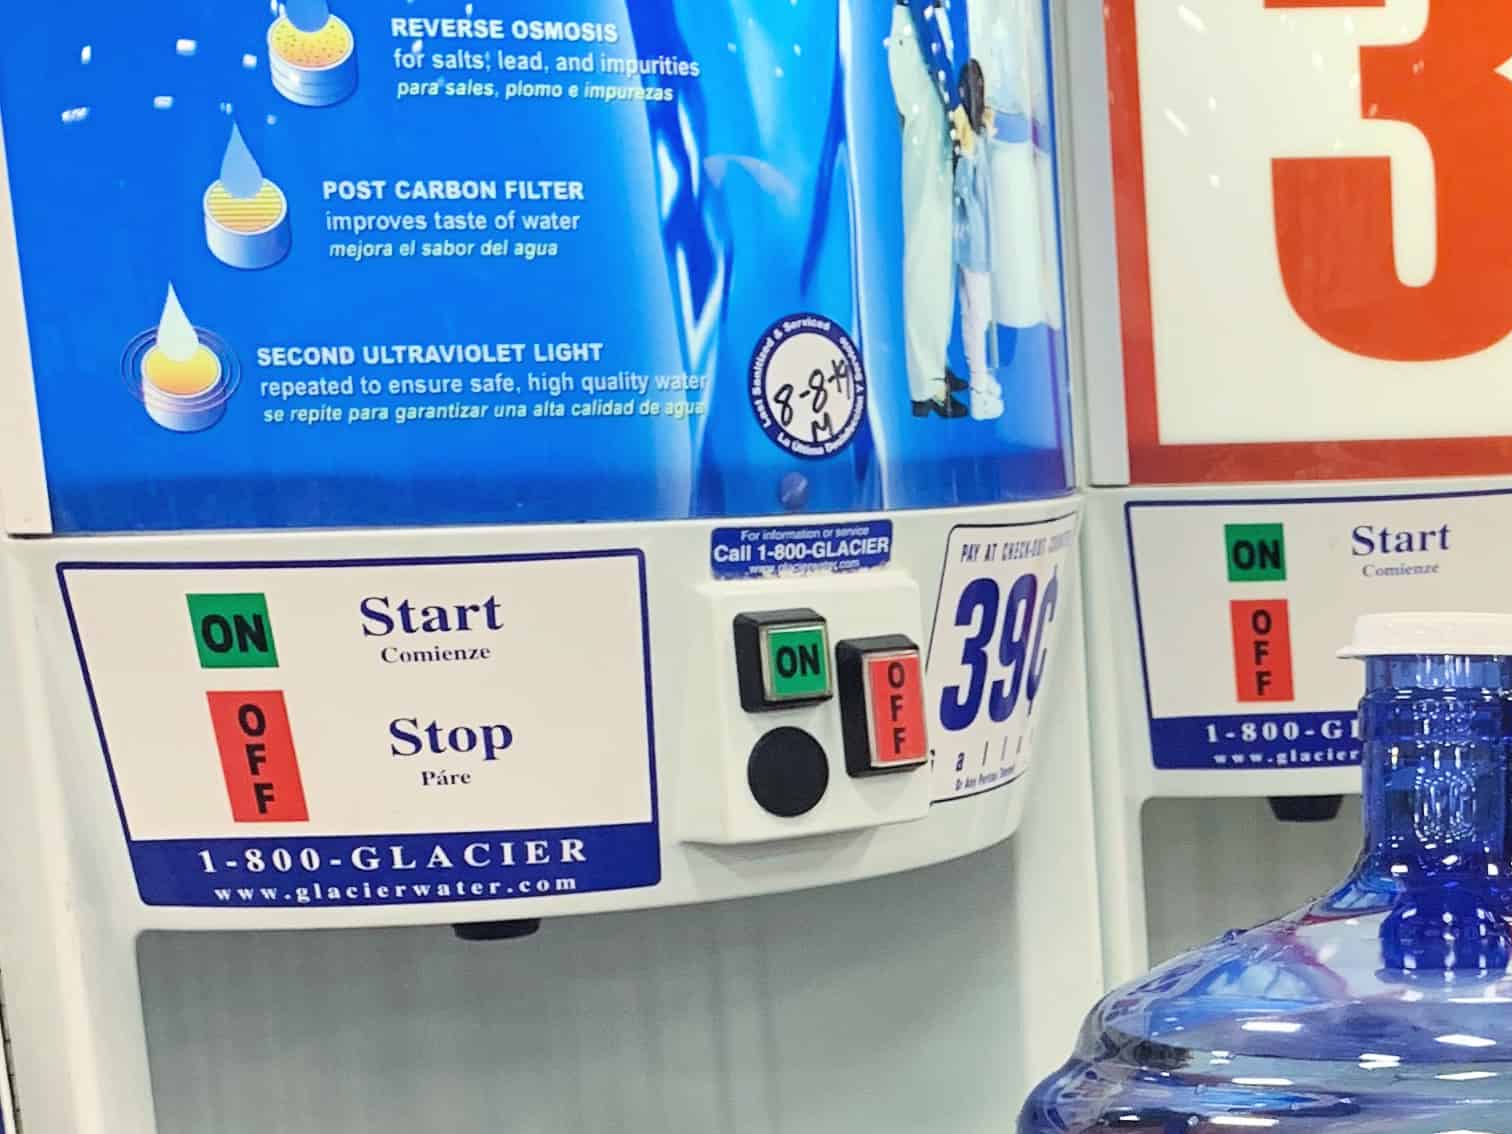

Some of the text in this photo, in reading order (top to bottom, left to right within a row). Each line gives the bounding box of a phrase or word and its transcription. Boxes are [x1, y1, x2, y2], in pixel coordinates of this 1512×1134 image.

[391, 18, 618, 42] REVERSE OSMOSIS
[393, 48, 424, 69] for
[497, 51, 549, 73] lead,
[556, 53, 594, 72] and
[600, 54, 700, 77] impurities
[397, 80, 438, 99] para
[505, 80, 562, 100] plomo
[568, 83, 579, 98] e
[584, 82, 673, 102] impurezas
[323, 180, 585, 200] POST CARBON FILTER
[326, 210, 581, 234] improves taste of water
[329, 240, 558, 261] mejora el sabor del agua
[256, 343, 603, 366] SECOND ULTRAVIOLET LIGHT
[260, 371, 708, 400] repeated to ensure safe, high quality water
[263, 400, 705, 424] se repite para garantizar una alta calidad de agua
[741, 530, 761, 542] For
[1352, 524, 1451, 557] Start
[714, 537, 890, 562] Call 1-800-GLACIER
[960, 543, 981, 562] PAY
[984, 543, 997, 562] AT
[1232, 540, 1281, 570] ON
[1362, 563, 1439, 578] Comienze
[359, 594, 505, 638] Start
[200, 613, 269, 655] ON
[381, 643, 491, 664] Comienze
[776, 644, 821, 679] ON
[1252, 609, 1272, 696] OFF
[887, 661, 906, 755] OFF
[389, 714, 514, 761] Stop
[238, 703, 277, 815] OFF
[421, 767, 473, 787] Páre
[199, 838, 588, 873] 1-800-GLACIER
[214, 876, 577, 904] www.glacierwater.com
